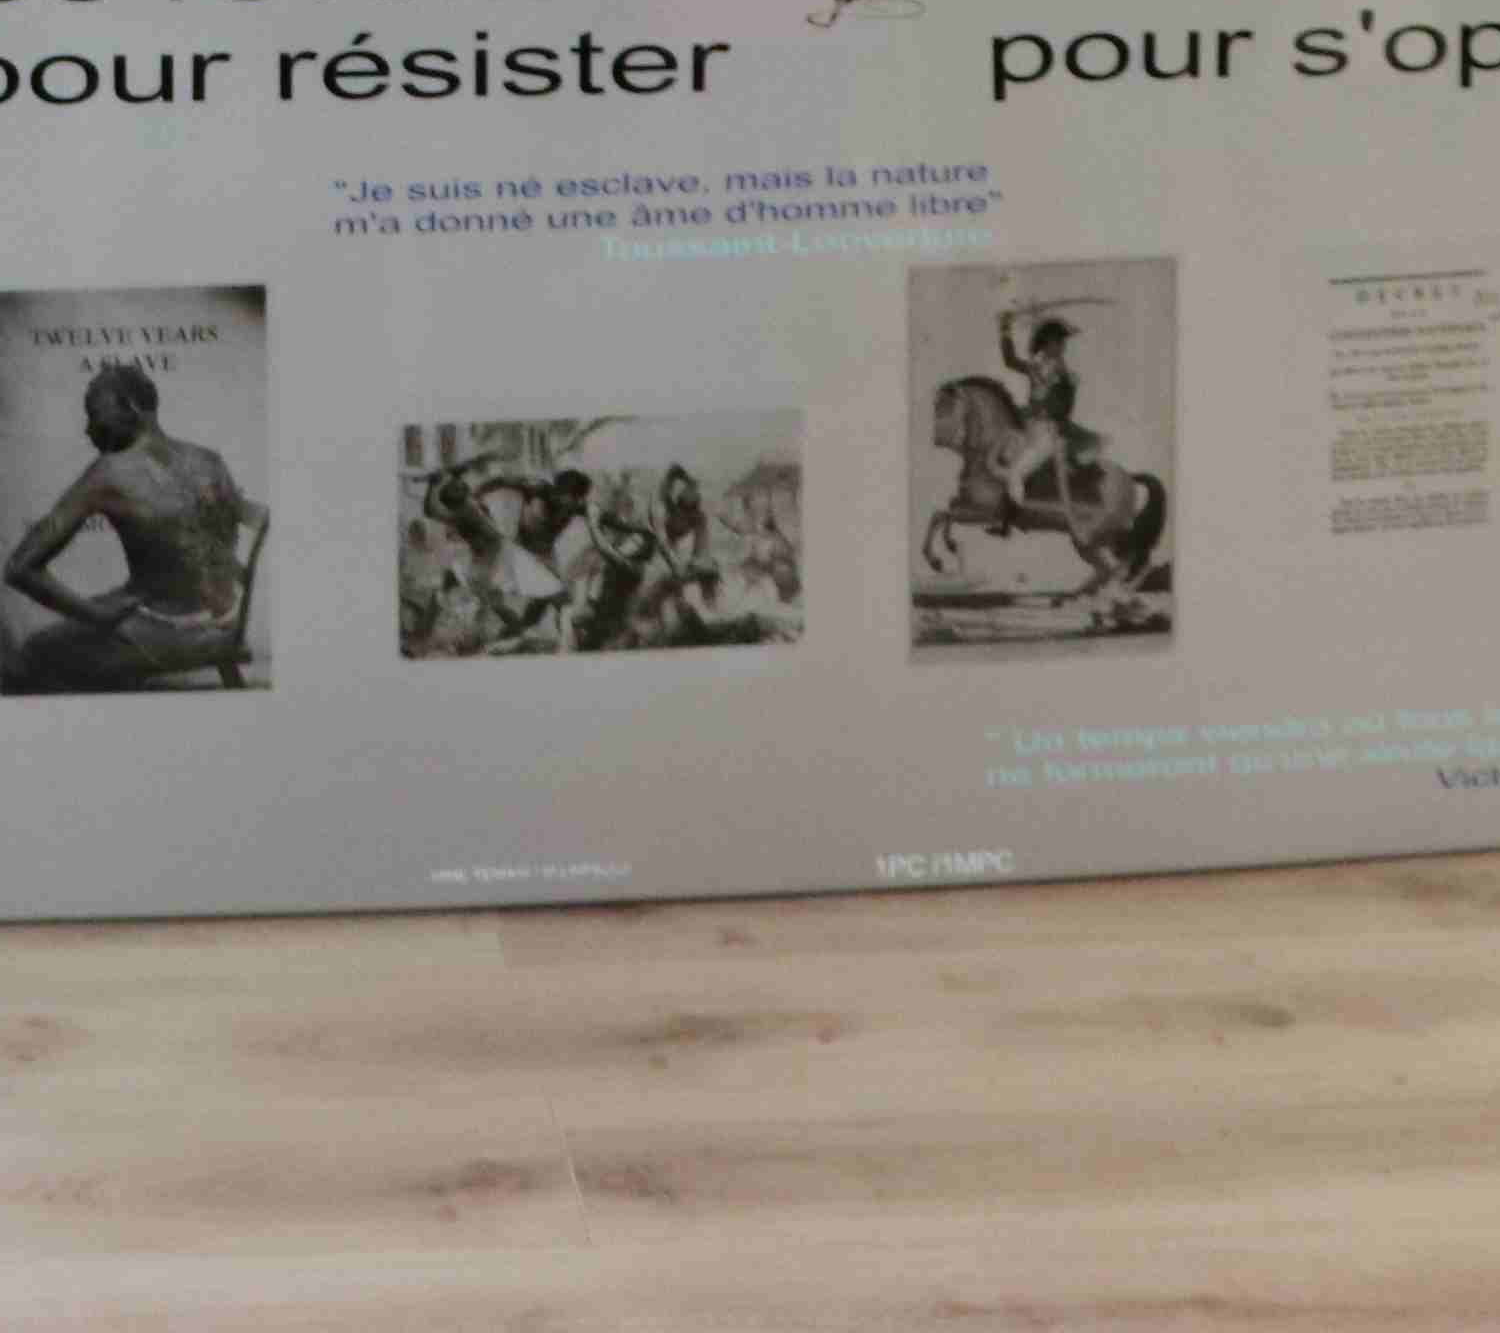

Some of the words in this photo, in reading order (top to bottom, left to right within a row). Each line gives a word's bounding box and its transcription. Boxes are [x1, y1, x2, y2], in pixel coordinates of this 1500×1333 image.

[277, 30, 732, 102] résister
[991, 28, 1254, 103] pour
[407, 178, 483, 201] suis
[496, 175, 543, 198] né
[556, 172, 710, 197] esclave,
[725, 168, 813, 191] mais
[825, 165, 857, 188] la
[871, 162, 989, 186] nature
[333, 211, 402, 235] m'a
[415, 208, 534, 233] donné
[547, 209, 617, 230] une
[631, 201, 713, 227] âme
[725, 197, 897, 224] d'homme
[29, 325, 134, 347] TWELVE
[138, 322, 219, 346] YEARS
